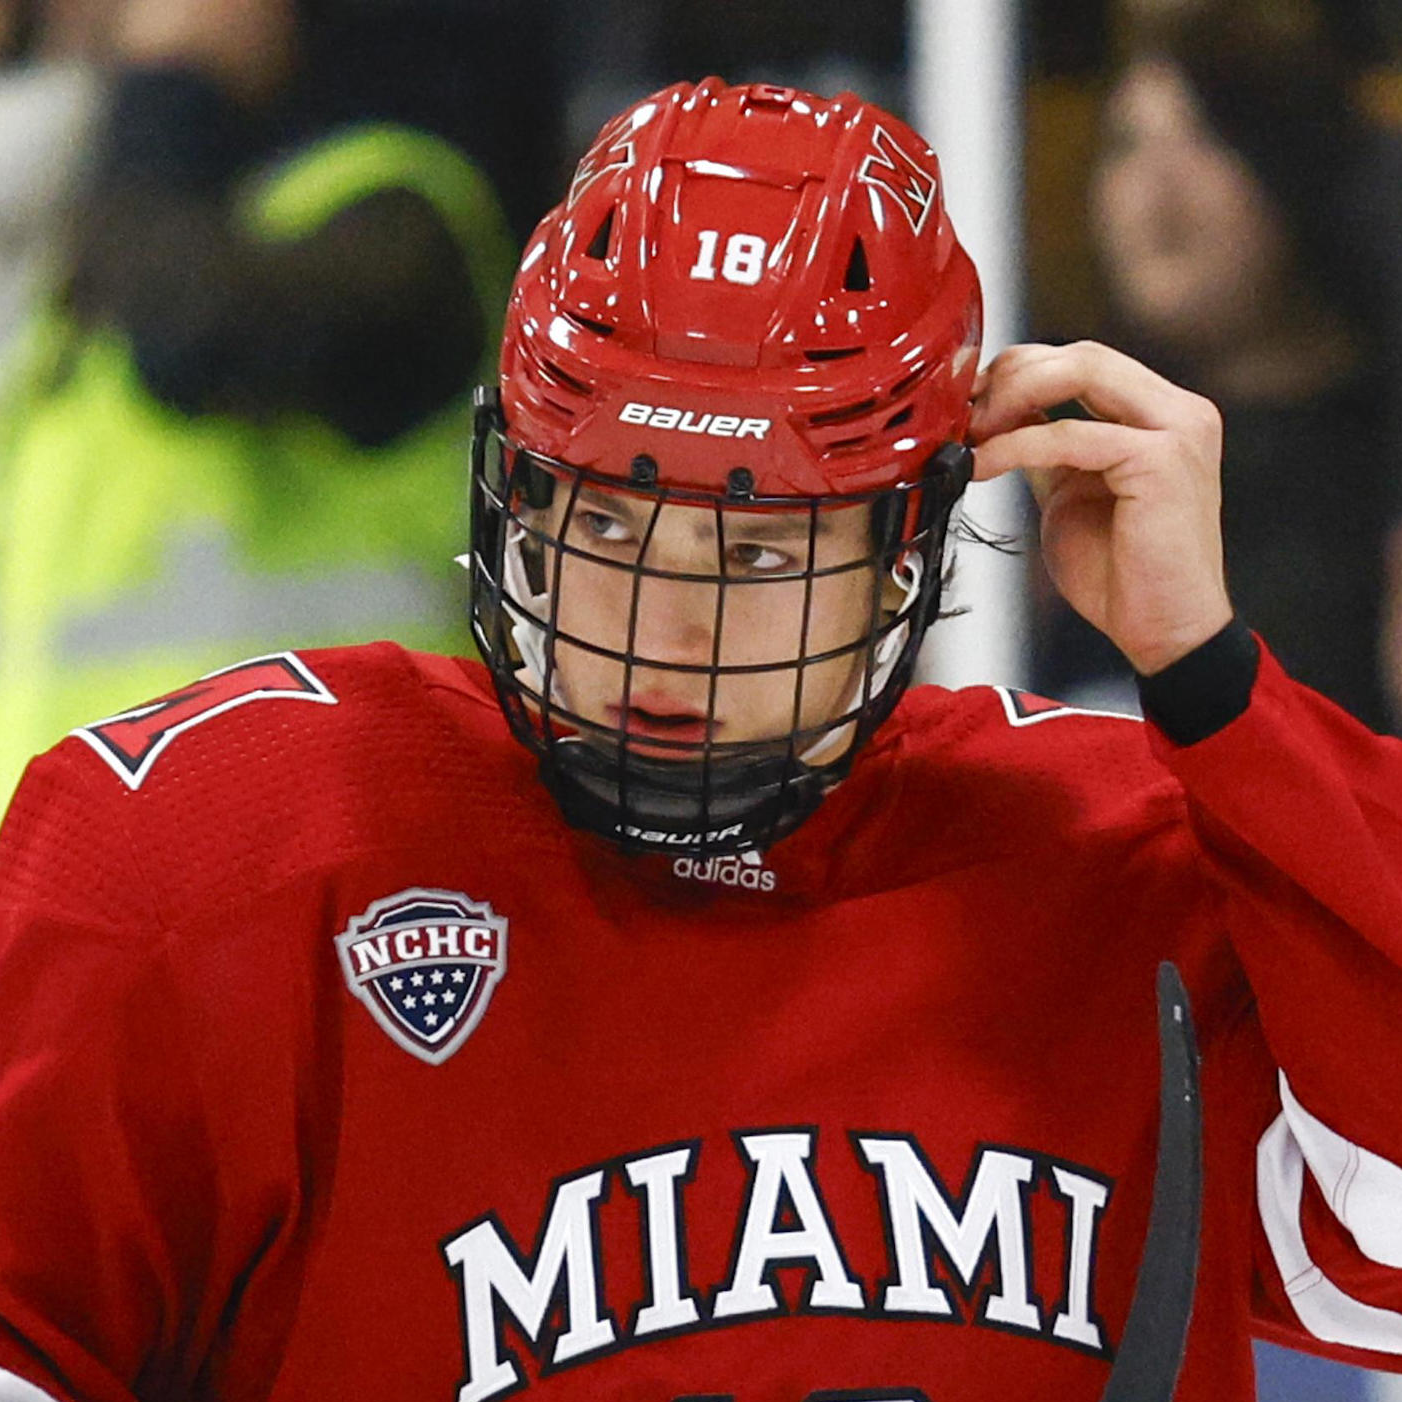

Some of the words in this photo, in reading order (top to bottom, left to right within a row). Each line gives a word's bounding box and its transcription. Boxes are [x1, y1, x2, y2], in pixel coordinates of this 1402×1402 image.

[689, 230, 768, 287] 18
[617, 402, 772, 441] BAUER
[673, 854, 777, 892] adidas
[351, 924, 492, 974] NCHC
